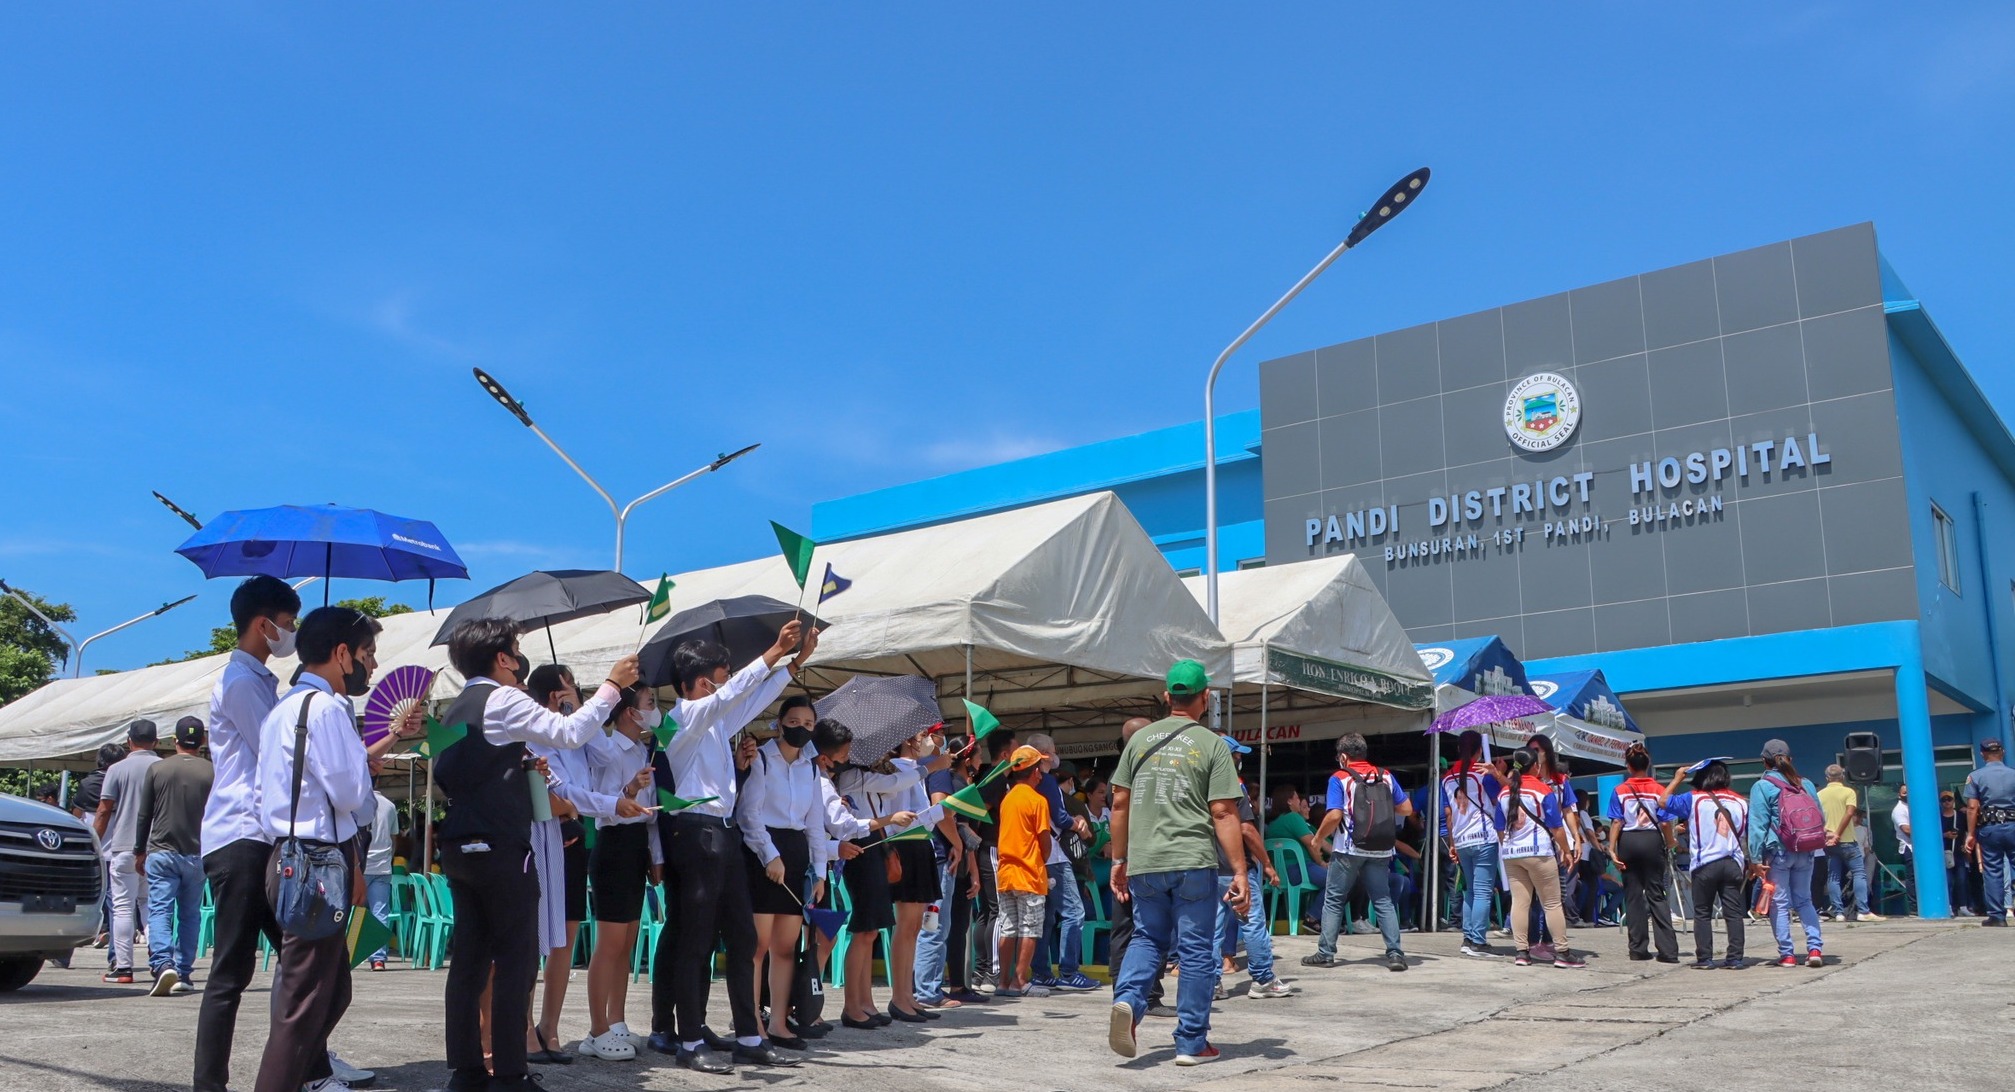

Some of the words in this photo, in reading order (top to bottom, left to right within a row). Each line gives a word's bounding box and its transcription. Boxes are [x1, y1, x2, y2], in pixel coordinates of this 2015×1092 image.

[1506, 380, 1531, 415] PROVINCE
[1546, 375, 1575, 403] BULACAN
[1512, 432, 1552, 449] OFFICIAL
[1554, 422, 1574, 442] SEAL
[1305, 504, 1399, 546] PANDI
[1428, 471, 1594, 527] DISTRICT
[1629, 432, 1831, 494] HOSPITAL
[1385, 534, 1485, 562] BUNSURAN,
[1493, 527, 1524, 546] 1ST
[1544, 515, 1610, 538] PANDI,
[1629, 495, 1723, 525] BULACAN
[1146, 732, 1195, 747] CHEKEE
[1232, 724, 1300, 742] ULACAN
